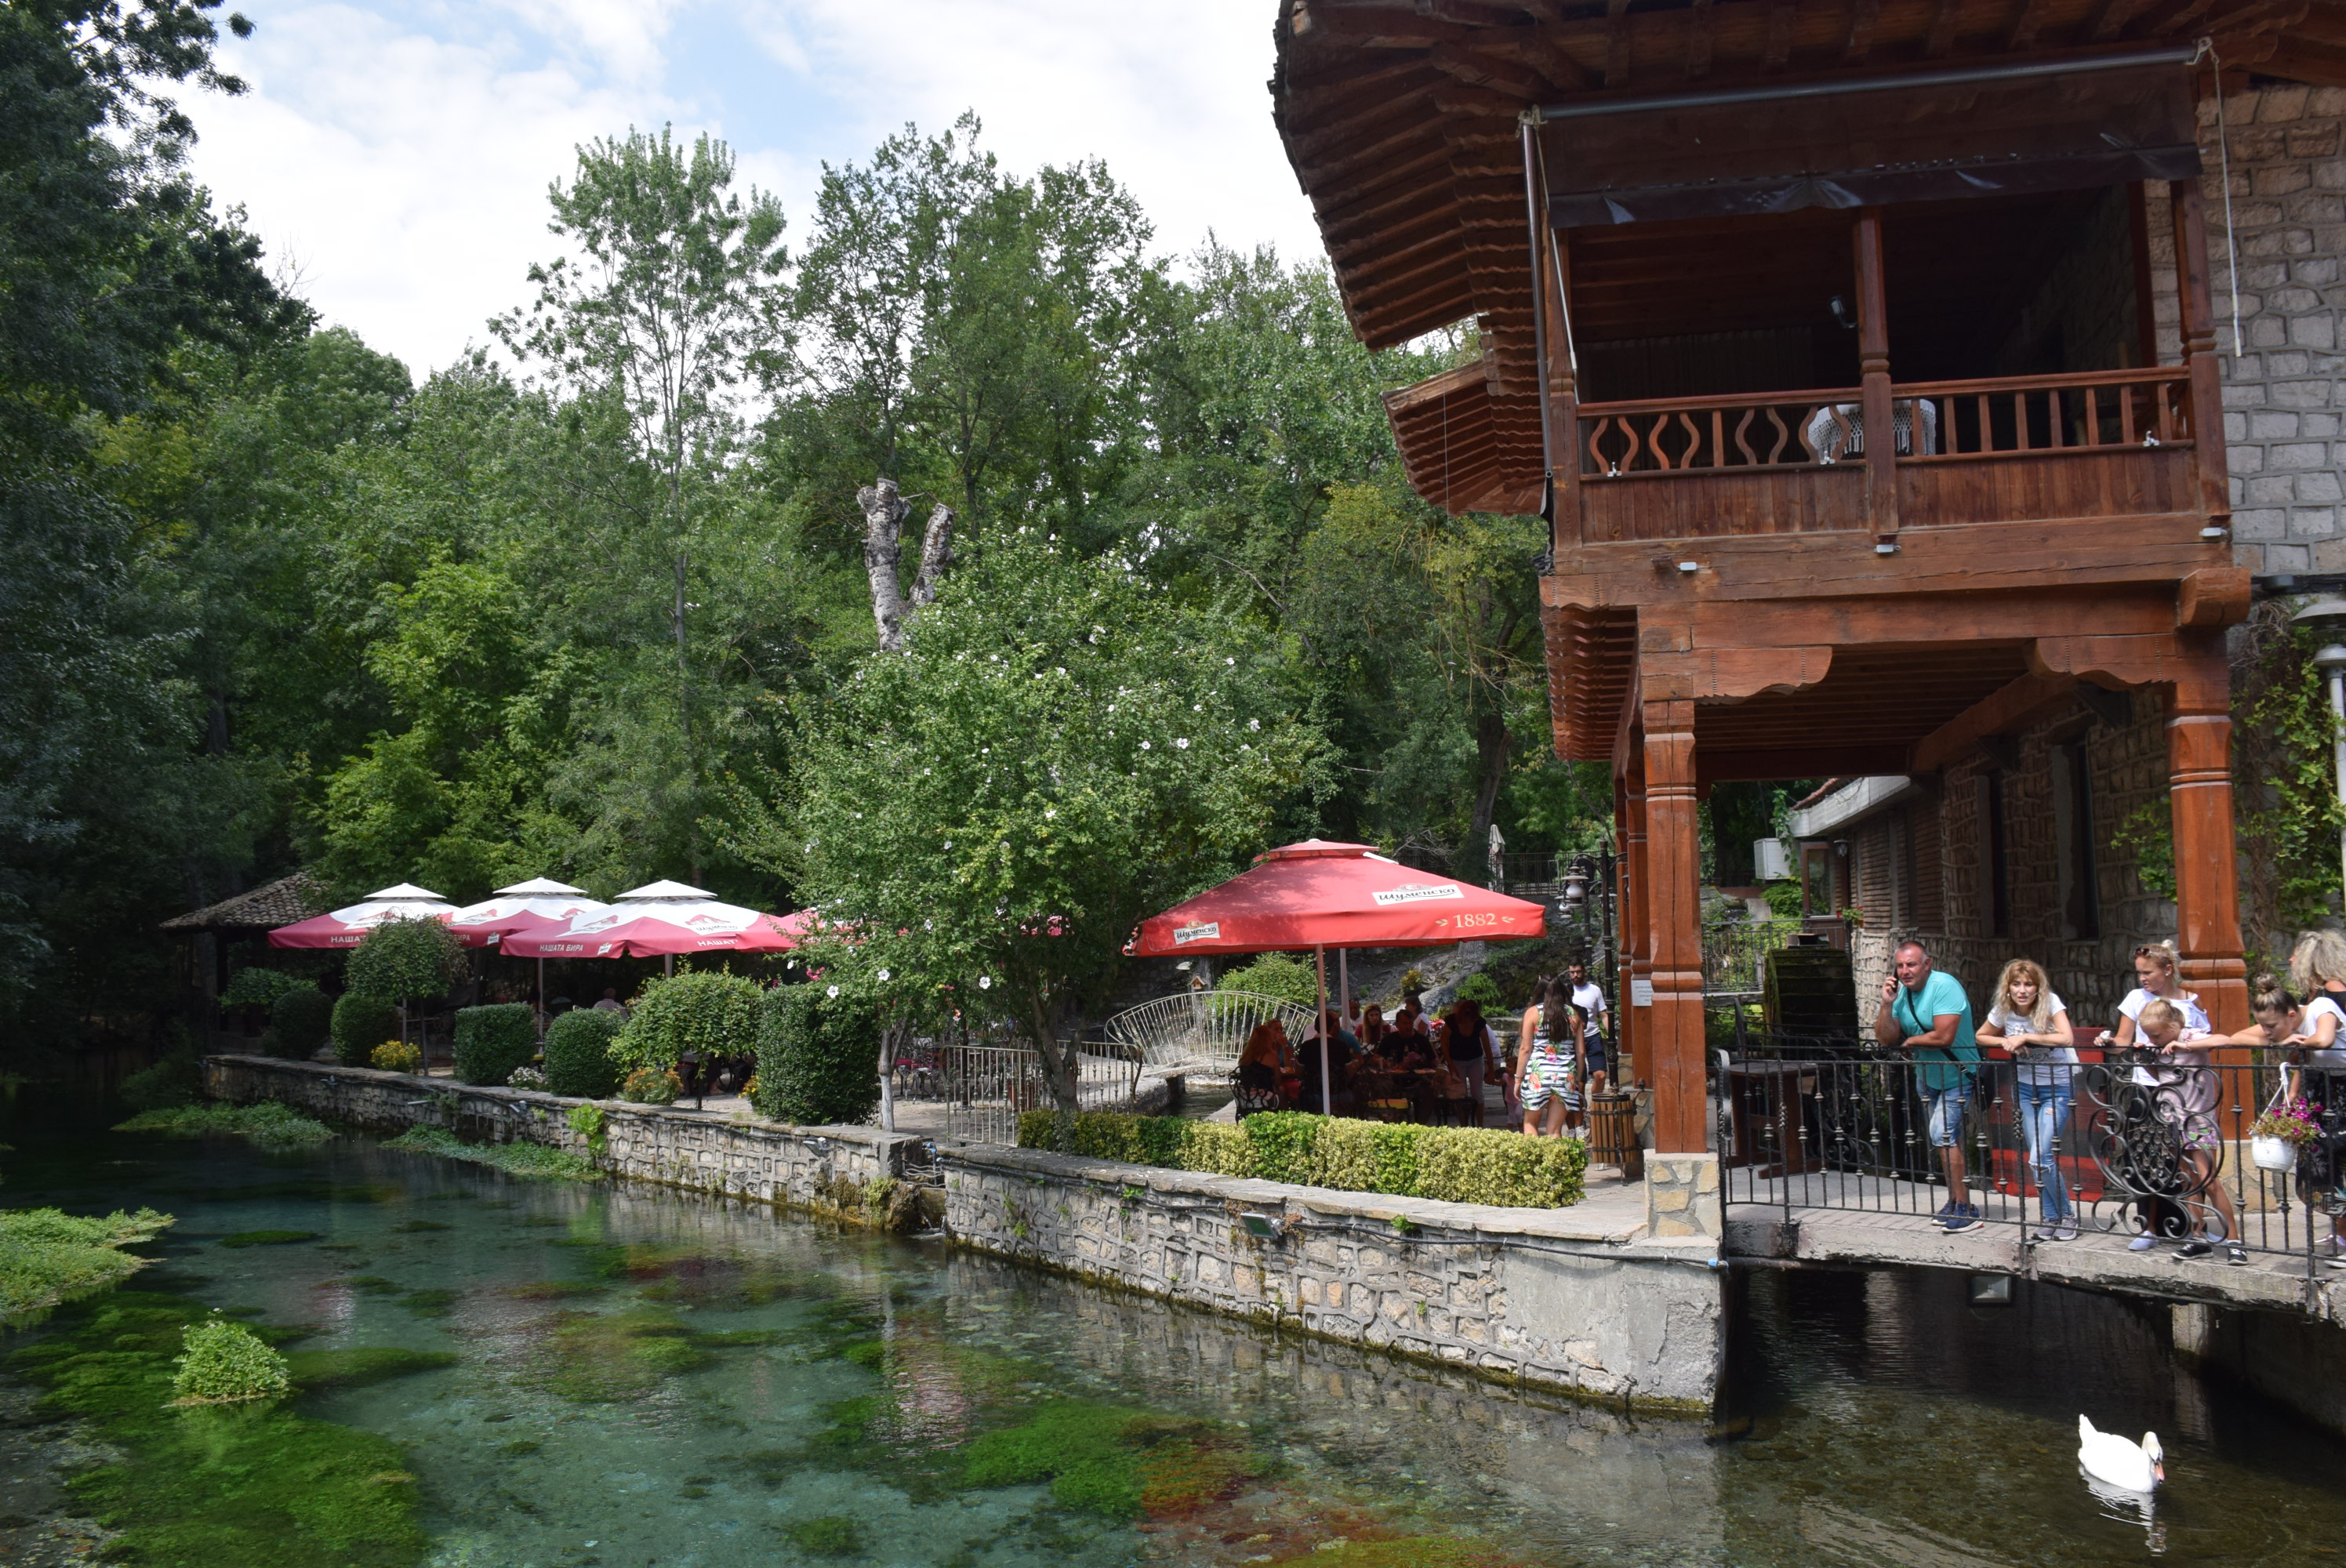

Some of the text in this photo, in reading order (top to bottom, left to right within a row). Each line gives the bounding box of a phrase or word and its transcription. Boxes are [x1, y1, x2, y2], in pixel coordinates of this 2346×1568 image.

[1378, 887, 1457, 902] Шуменско
[1453, 913, 1498, 928] 1882
[1176, 927, 1217, 940] Шуменско
